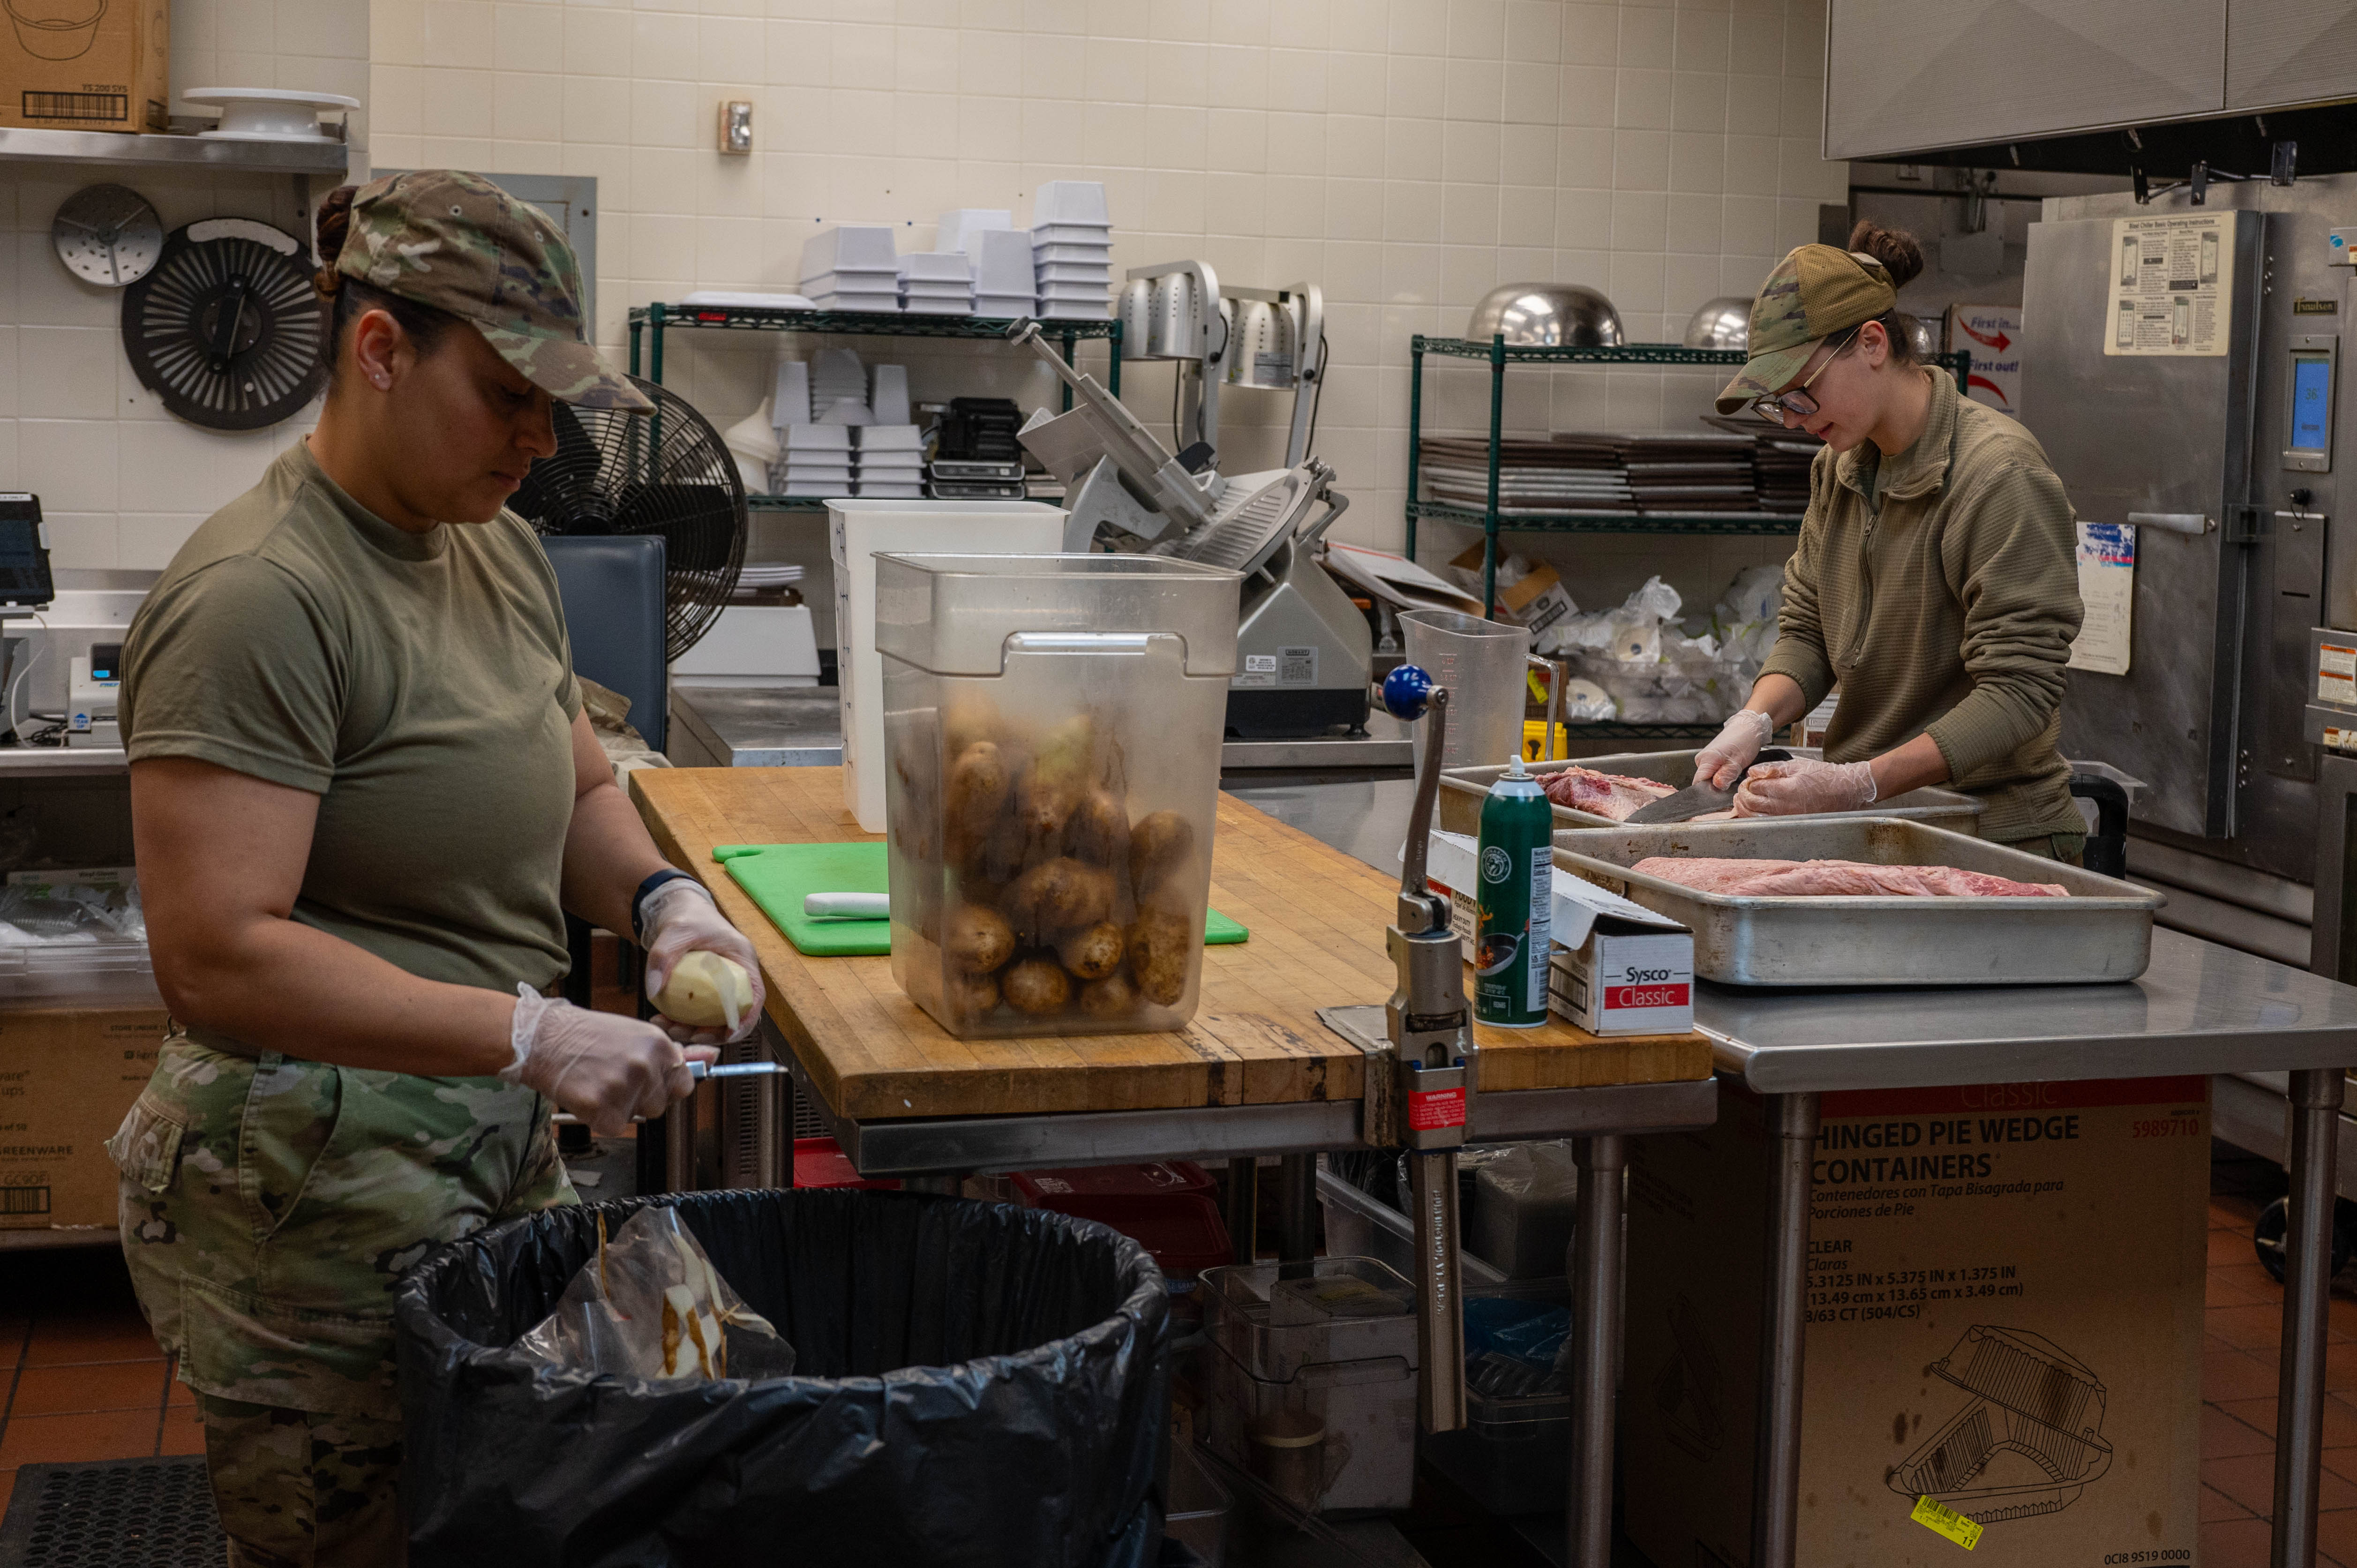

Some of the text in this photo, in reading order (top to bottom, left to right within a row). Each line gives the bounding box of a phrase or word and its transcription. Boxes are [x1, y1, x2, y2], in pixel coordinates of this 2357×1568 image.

[1970, 316, 1996, 328] First
[1995, 360, 2019, 372] out!
[1455, 891, 1472, 905] FOOD
[1453, 914, 1462, 923] HEAVY
[1626, 966, 1669, 985] Sysco
[1619, 987, 1675, 1006] Classic
[1426, 1092, 1457, 1102] WARNING
[1961, 1081, 2058, 1108] Classic
[1815, 1115, 2079, 1150] HINGED PIE WEDGE
[2132, 1118, 2199, 1139] 5989710
[1811, 1153, 1992, 1185] CONTAINERS
[1810, 1179, 2064, 1203] Contenedores con Tapa Bisagrada para
[1809, 1202, 1914, 1219] Porciones de Pie
[1808, 1240, 1853, 1254] CLEAR
[1807, 1258, 1848, 1272] Claras
[1807, 1266, 2016, 1289] 5.3125 IN x 5.375 IN x 1.375 IN
[1852, 1294, 1873, 1304] cm
[1877, 1293, 1885, 1302] x
[1889, 1288, 1927, 1302] 13.65
[1930, 1290, 1951, 1300] cm
[1954, 1289, 1963, 1298] x
[1966, 1284, 1995, 1298] 3.49
[1998, 1282, 2024, 1297] cm)
[1839, 1307, 1857, 1320] CT
[1861, 1304, 1921, 1321] (504/CS)
[1963, 1536, 1973, 1547] 11
[2161, 1549, 2191, 1560] 0000
